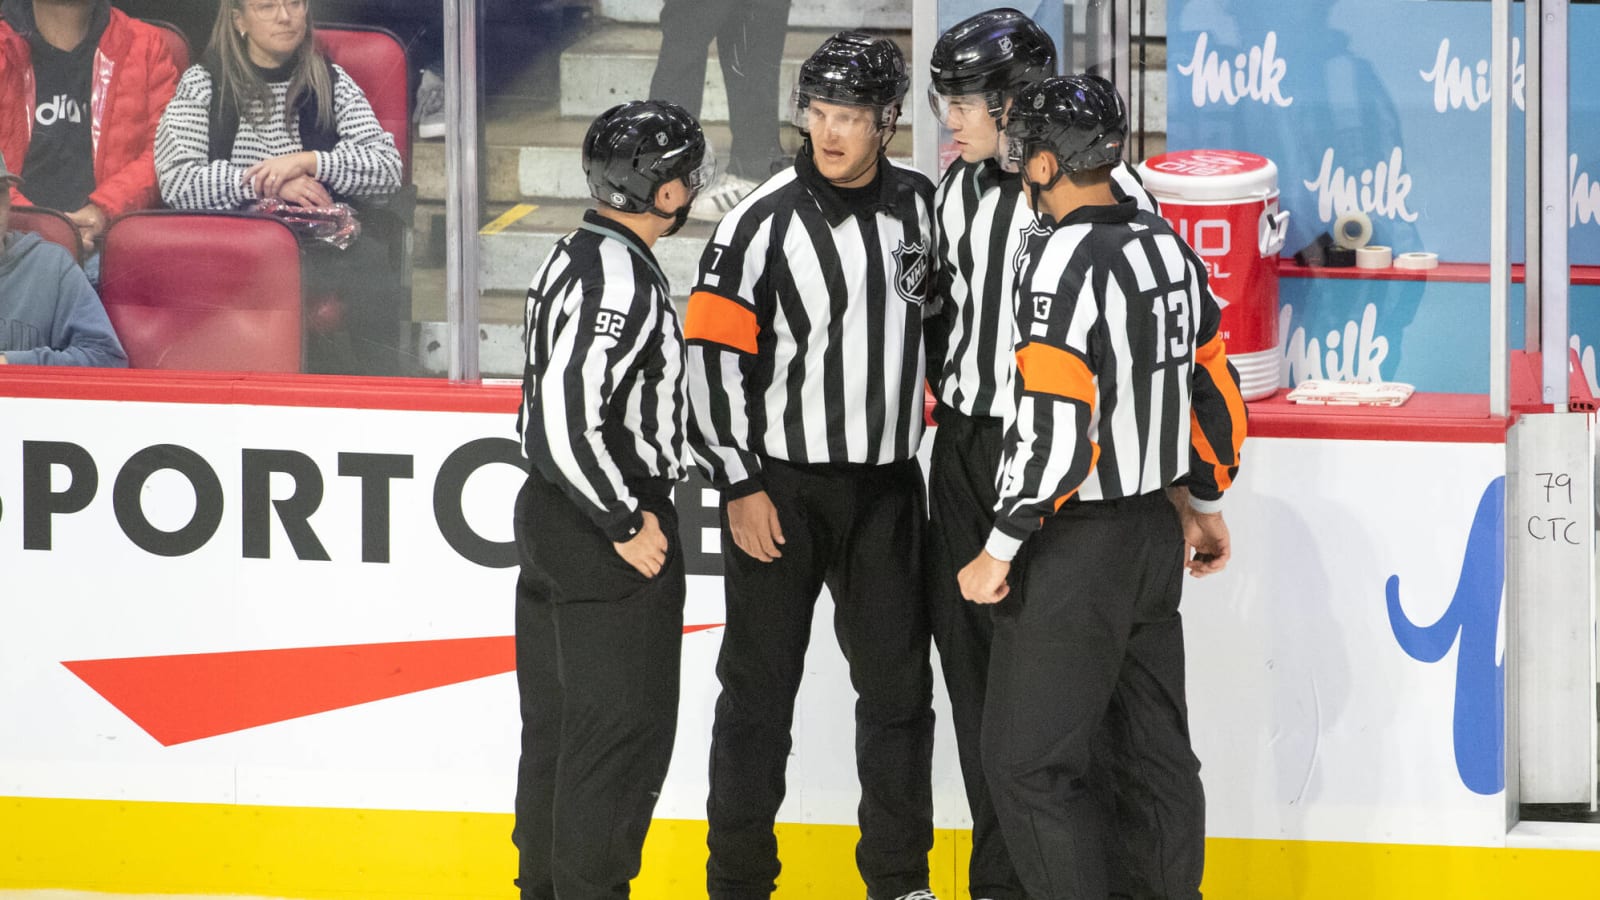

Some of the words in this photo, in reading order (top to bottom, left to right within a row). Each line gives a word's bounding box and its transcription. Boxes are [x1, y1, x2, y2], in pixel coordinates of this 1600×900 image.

[1419, 37, 1525, 113] Mik
[712, 247, 723, 270] 7
[905, 258, 927, 292] NHL
[1033, 296, 1051, 320] 13
[594, 311, 626, 338] 92
[1151, 289, 1190, 362] 13
[1535, 472, 1572, 504] 79
[1527, 515, 1580, 546] CTC
